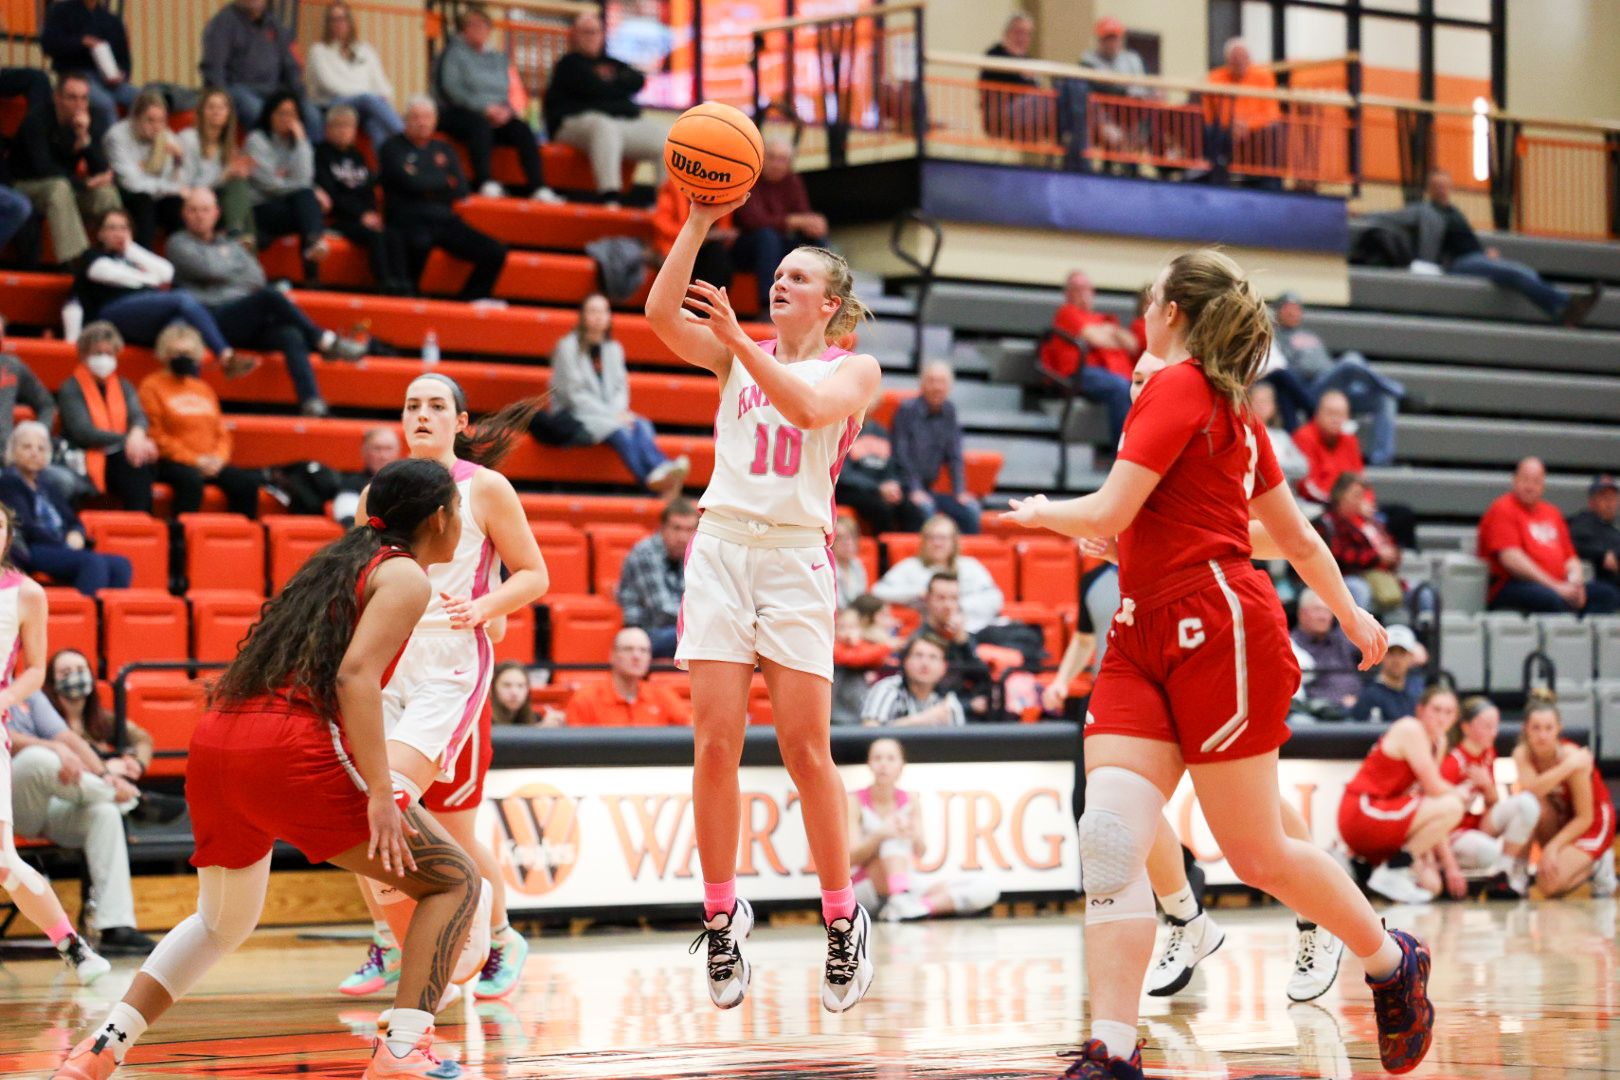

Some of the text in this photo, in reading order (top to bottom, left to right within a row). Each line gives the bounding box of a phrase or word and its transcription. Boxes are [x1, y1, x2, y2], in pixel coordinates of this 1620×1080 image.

[671, 150, 731, 183] Wilson
[750, 423, 803, 477] 10
[1178, 617, 1205, 649] C
[597, 786, 1066, 881] WRURG
